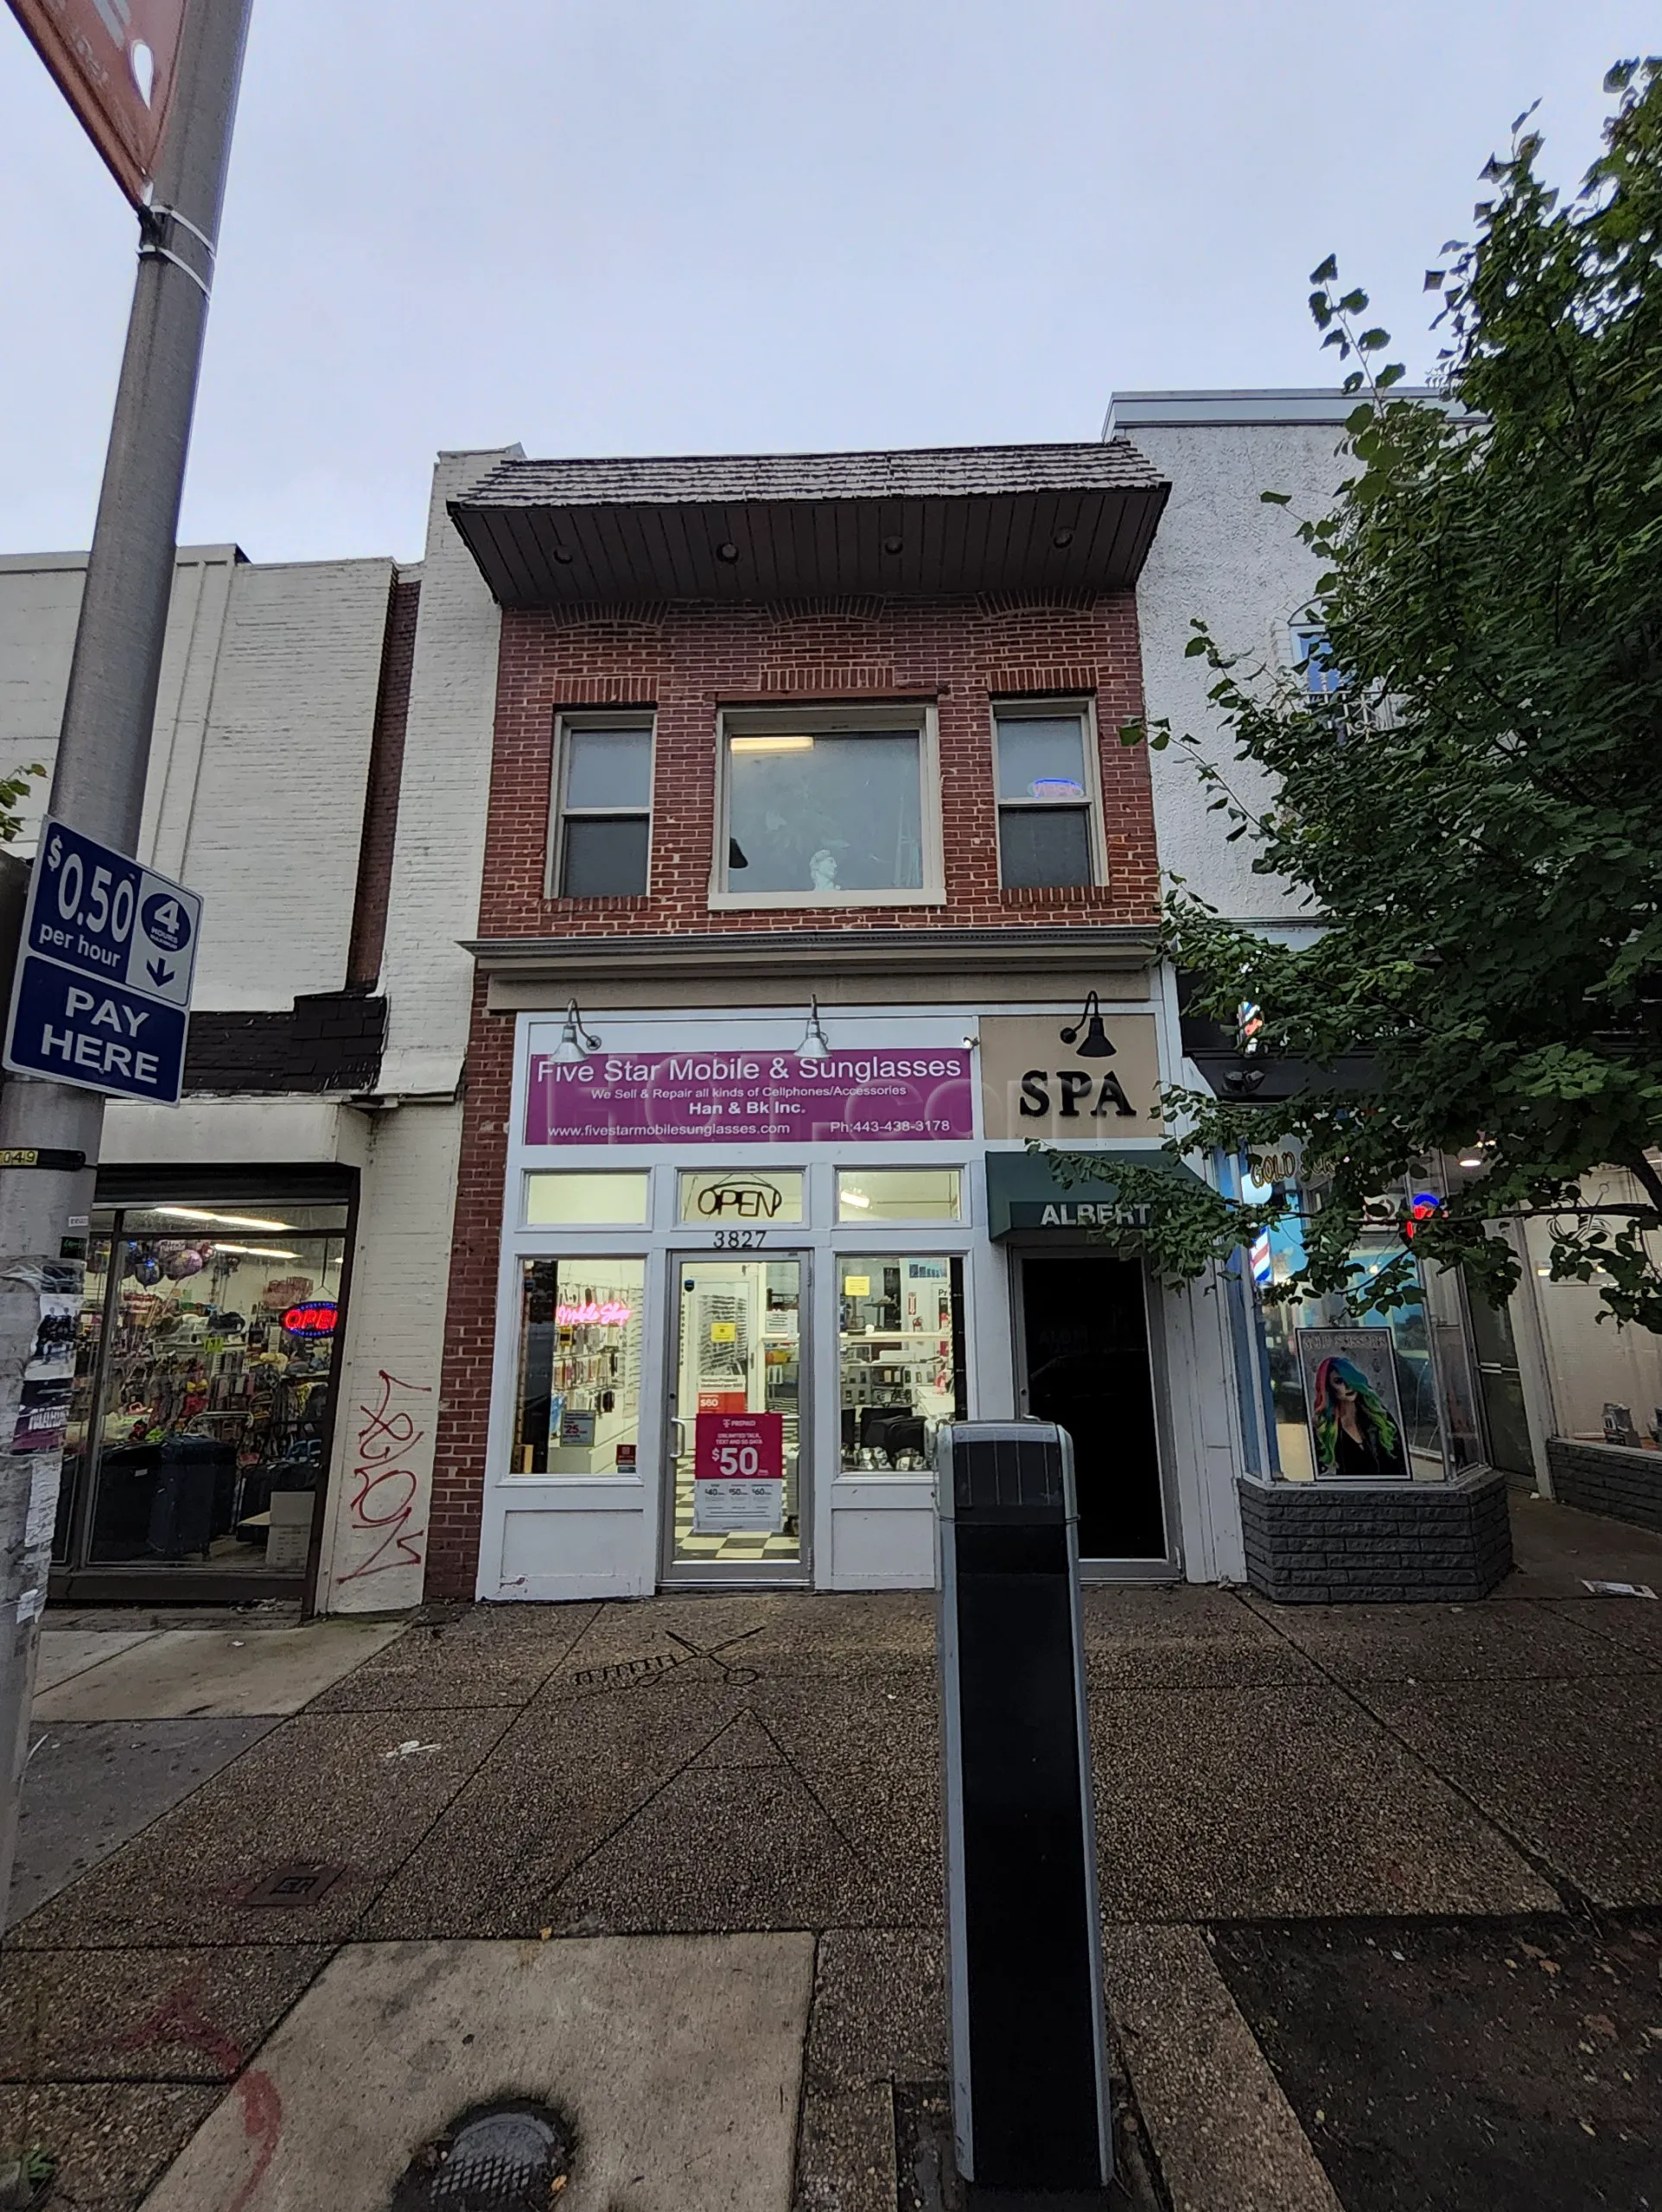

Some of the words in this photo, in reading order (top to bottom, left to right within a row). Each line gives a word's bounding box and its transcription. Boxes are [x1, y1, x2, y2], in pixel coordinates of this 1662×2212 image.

[154, 899, 180, 934] 4
[39, 924, 74, 949] per
[78, 934, 121, 969] hour
[65, 986, 150, 1038] PAY
[41, 1023, 160, 1084] HERE
[538, 1059, 595, 1083] Five
[604, 1058, 661, 1082] Star
[669, 1058, 760, 1081] Mobile
[769, 1057, 790, 1079] &
[799, 1056, 961, 1084] Sunglasses
[591, 1089, 612, 1100] We
[614, 1088, 637, 1099] Sell
[640, 1089, 649, 1099] &
[653, 1088, 692, 1101] Repair
[695, 1087, 709, 1098] all
[712, 1087, 744, 1098] kinds
[747, 1087, 760, 1097] of
[761, 1085, 907, 1097] Cellphones/Accessories
[689, 1102, 723, 1115] Han
[728, 1102, 741, 1115] &
[747, 1102, 770, 1114] Bk
[774, 1101, 806, 1114] Inc.
[1020, 1070, 1137, 1117] SPA
[547, 1123, 791, 1137] www.fivestarmobilesunglasses.com
[0, 1151, 35, 1163] 049
[1251, 1151, 1296, 1189] GOLD
[697, 1188, 777, 1218] OPEN
[1041, 1203, 1151, 1225] ALBERT
[713, 1230, 767, 1249] 3827
[711, 1446, 758, 1476] $50
